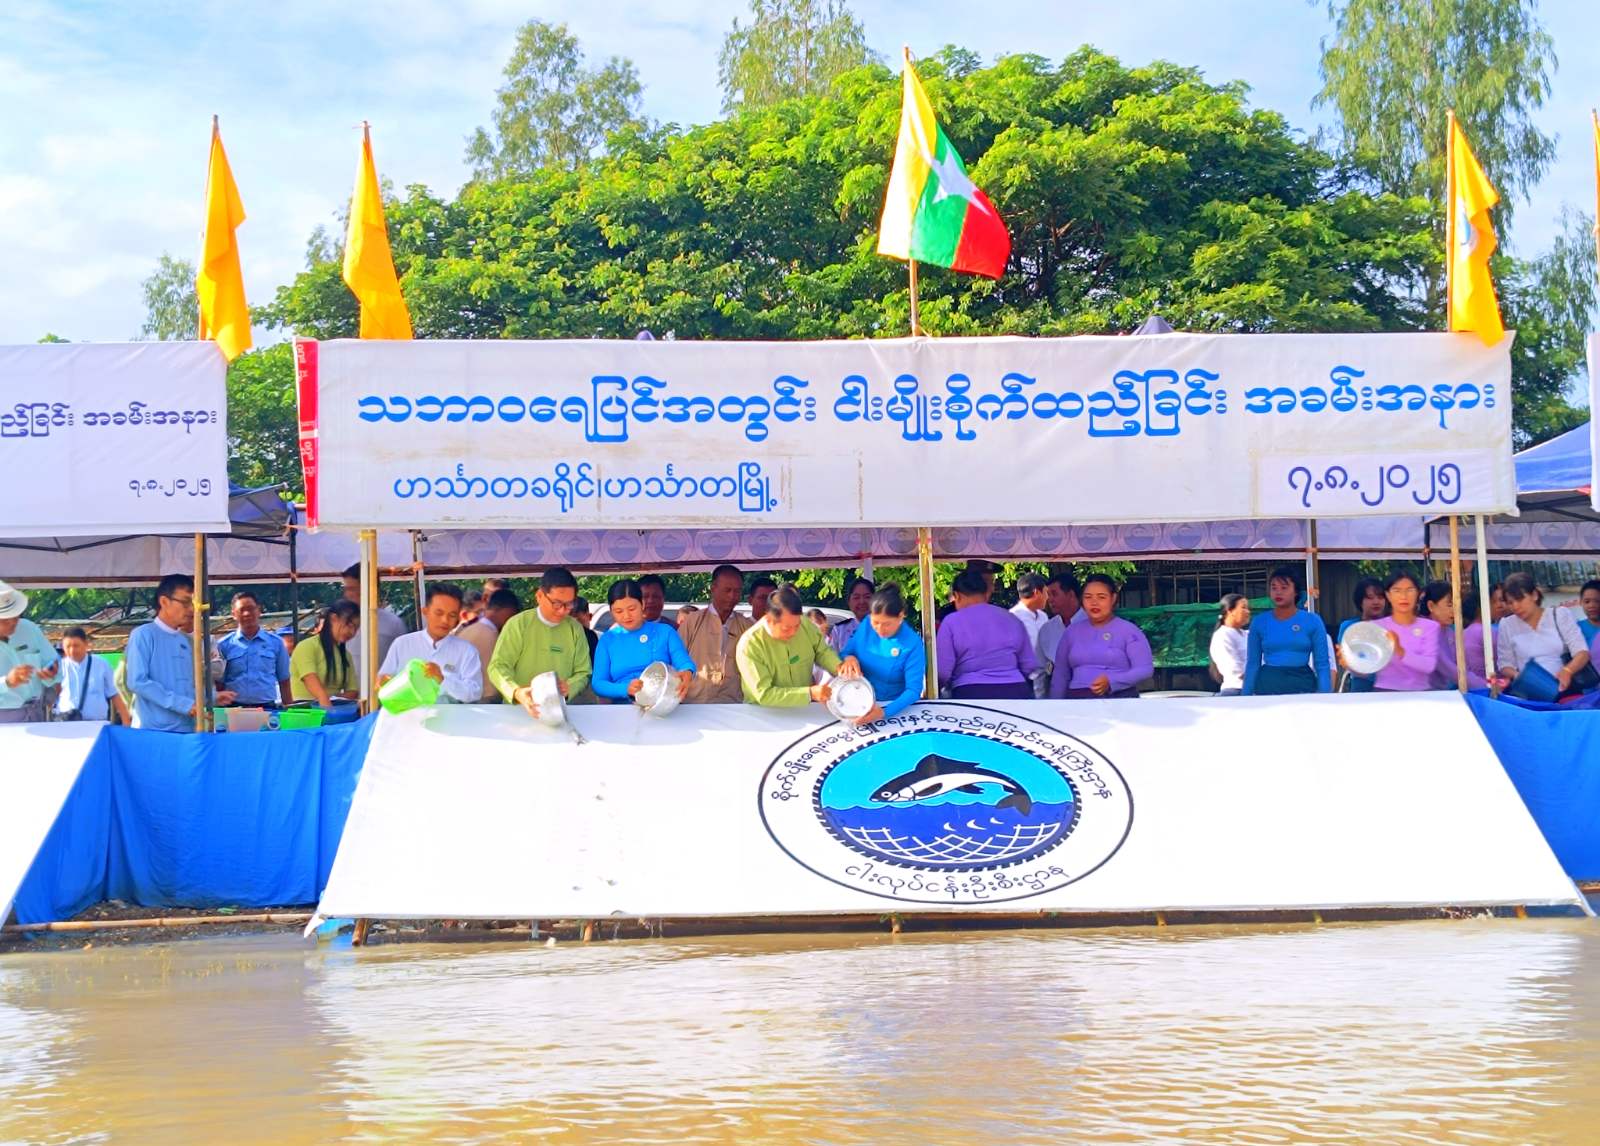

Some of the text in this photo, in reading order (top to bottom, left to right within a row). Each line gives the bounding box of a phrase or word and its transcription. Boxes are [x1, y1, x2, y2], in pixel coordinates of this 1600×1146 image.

[83, 400, 218, 434] အခမ်းအနား
[358, 364, 1496, 442] သဘာဝရေပြင်အတွင်း ငါးမျိုးစိုက်ထည့်ခြင်း အခမ်းအနား
[1287, 462, 1462, 508] ၇.၈.၂၀၂၅
